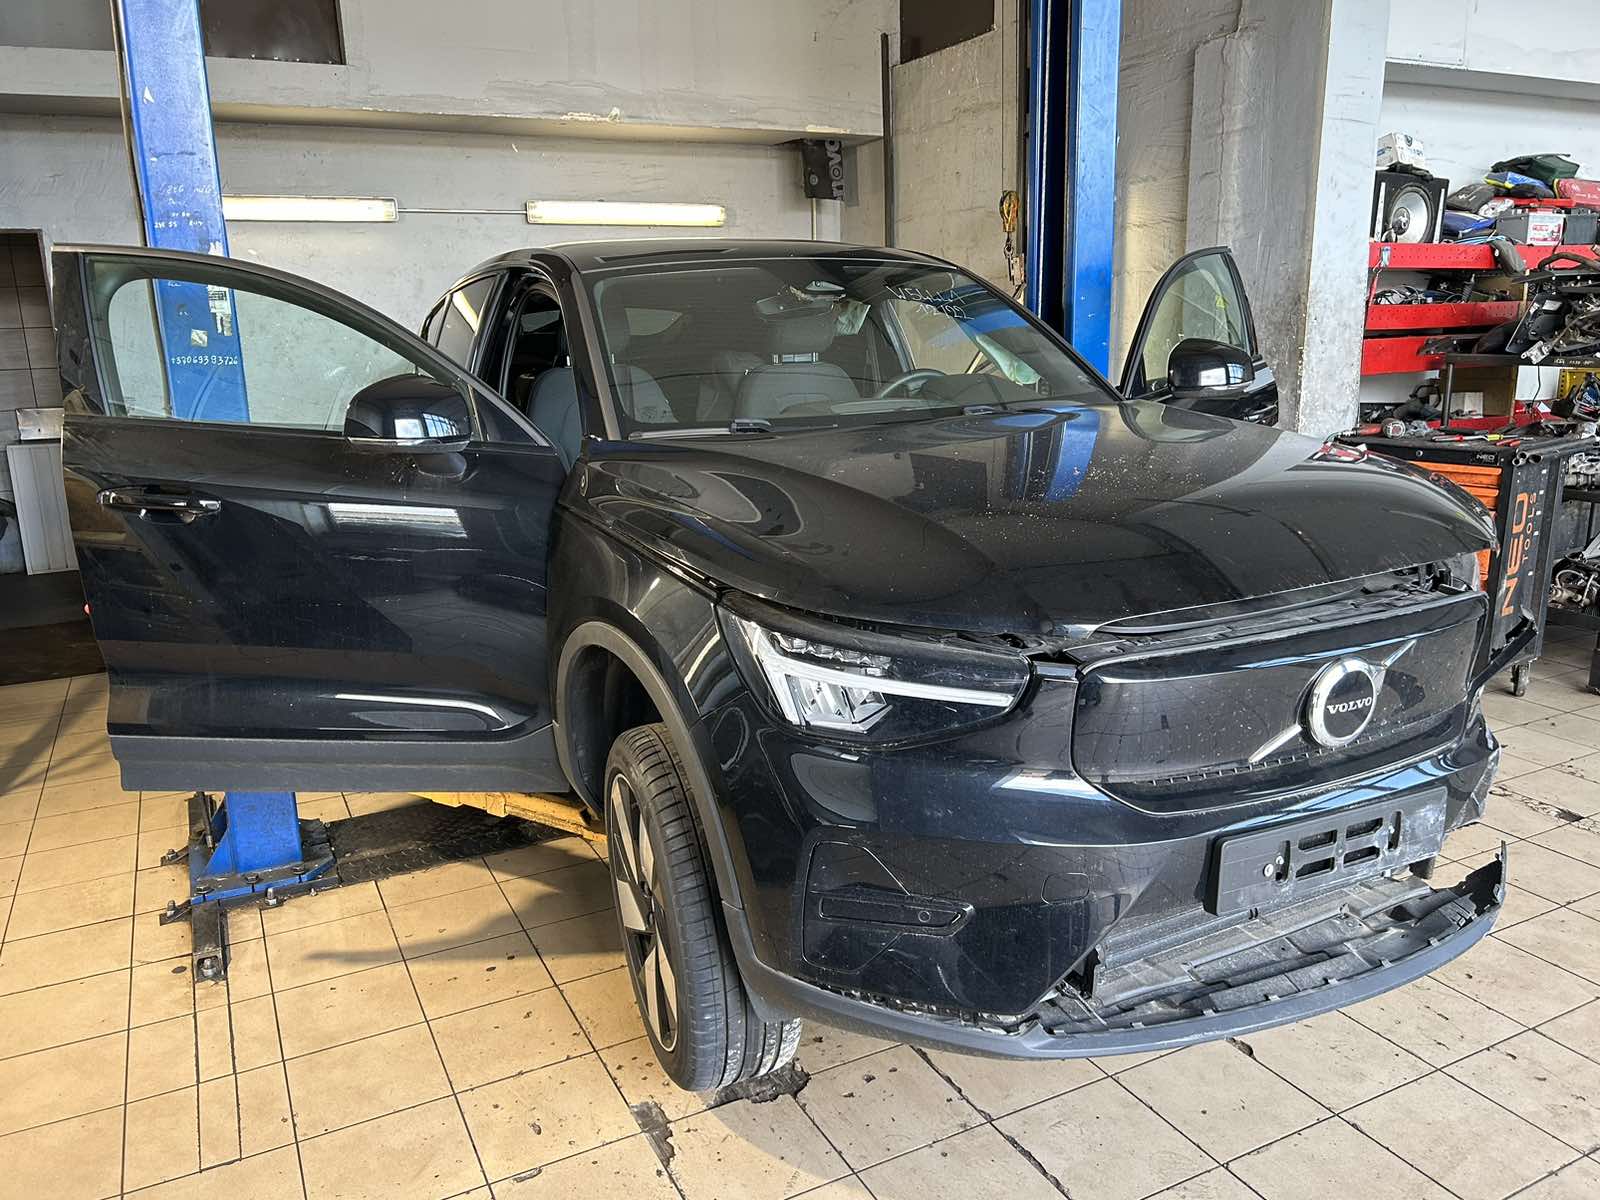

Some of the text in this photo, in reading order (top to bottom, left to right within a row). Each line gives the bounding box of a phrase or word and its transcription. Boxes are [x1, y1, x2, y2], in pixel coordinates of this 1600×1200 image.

[1502, 492, 1529, 617] NEO
[1522, 492, 1537, 565] TOOLS
[1326, 696, 1372, 714] VOLVO
